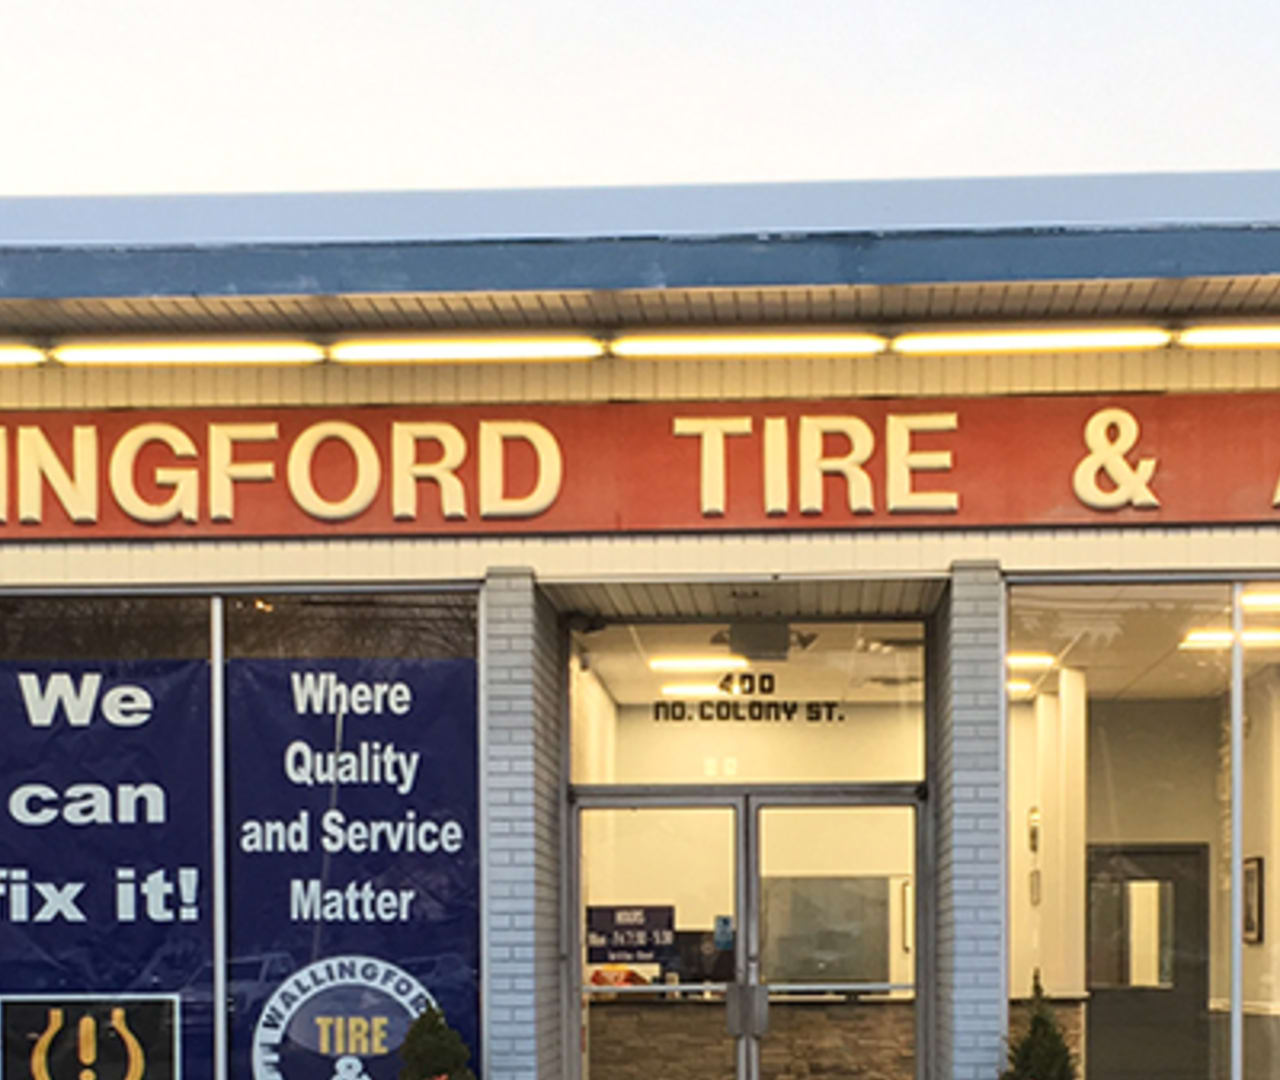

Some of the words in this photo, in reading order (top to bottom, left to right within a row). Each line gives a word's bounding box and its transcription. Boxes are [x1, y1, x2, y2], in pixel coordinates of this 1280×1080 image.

[674, 413, 958, 512] TIRE
[1073, 409, 1159, 514] &
[19, 674, 152, 725] We
[291, 673, 412, 714] Where
[719, 673, 775, 695] 400
[699, 701, 798, 721] COLONY
[806, 701, 845, 721] ST.
[285, 742, 419, 794] Quality
[10, 784, 164, 824] can
[242, 811, 308, 851] and
[322, 810, 462, 852] Service
[117, 869, 197, 921] it!
[291, 880, 414, 920] Matter
[263, 960, 428, 1030] WALLINGFOR
[315, 1017, 389, 1055] TIRE
